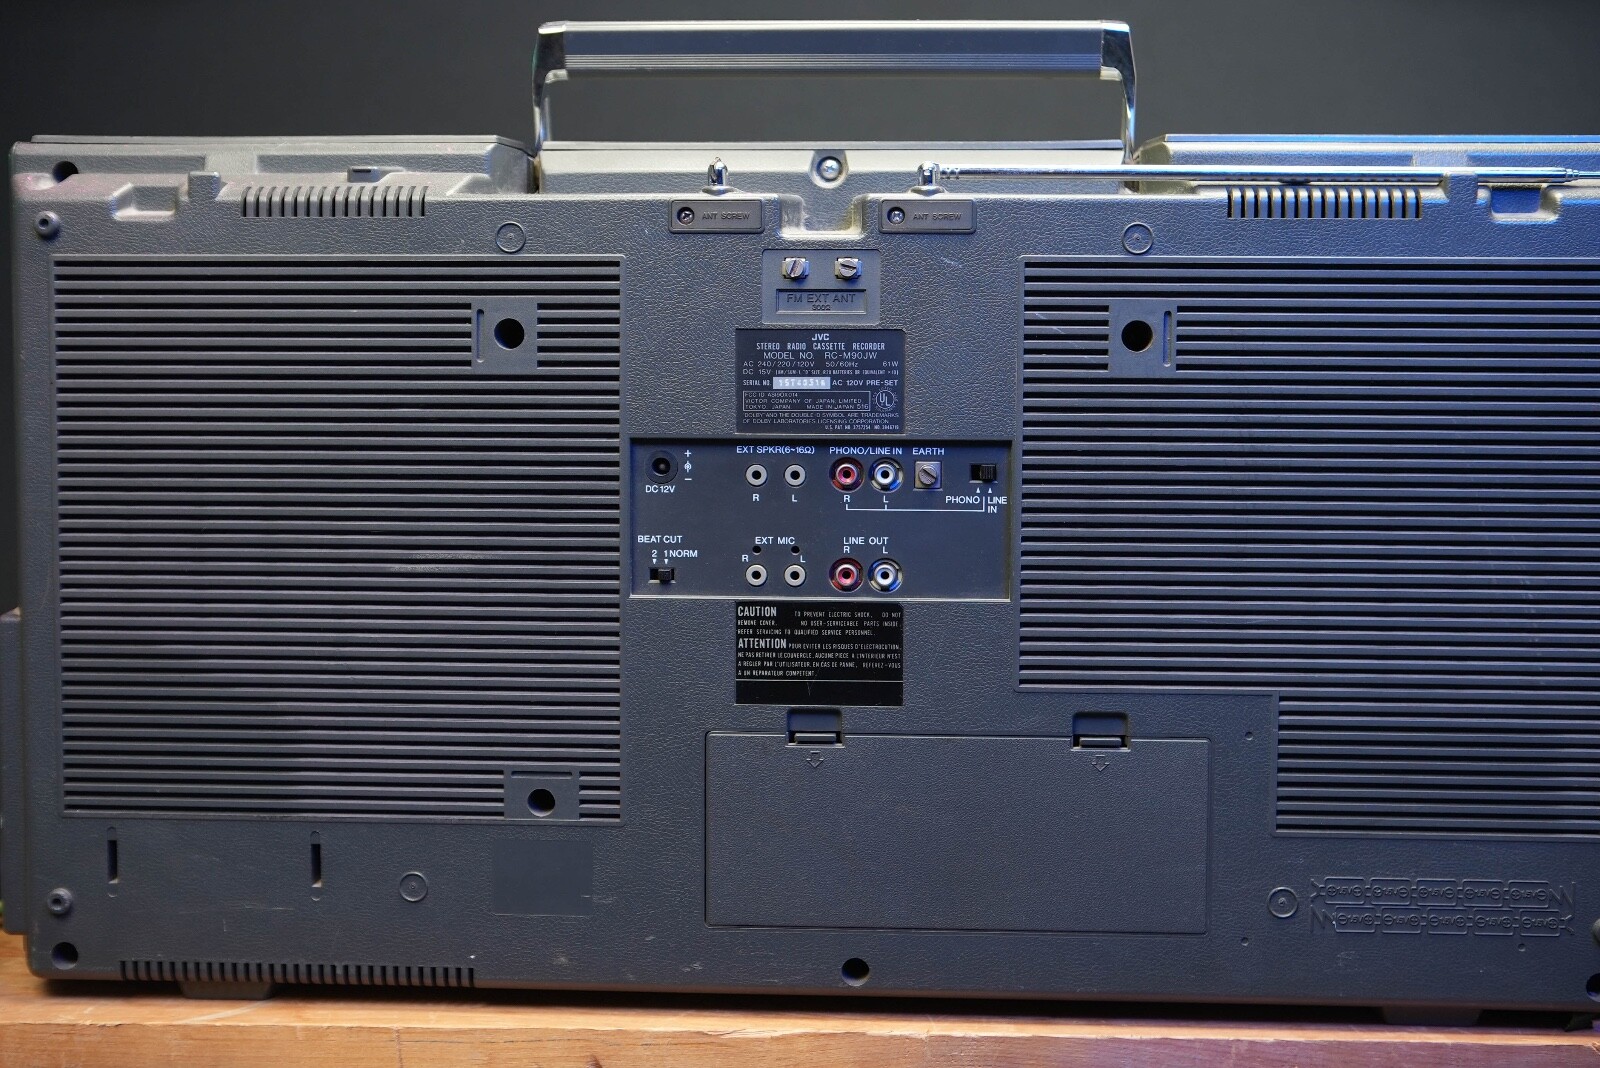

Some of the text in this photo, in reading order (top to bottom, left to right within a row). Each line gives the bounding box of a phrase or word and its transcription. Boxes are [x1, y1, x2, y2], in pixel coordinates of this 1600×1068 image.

[720, 212, 750, 220] SCREW
[787, 294, 856, 302] FM EXT ANT
[880, 393, 890, 406] UL
[736, 446, 754, 454] EXT
[829, 447, 903, 455] PHONO/LINE IN
[645, 485, 675, 493] DC 12V
[752, 494, 760, 502] R
[791, 494, 798, 502] L
[844, 495, 850, 503] R
[883, 495, 889, 503] L
[945, 496, 980, 504] PHONO
[988, 496, 1008, 504] LINE
[988, 506, 997, 514] IN
[638, 535, 682, 543] BEAT CUT
[755, 537, 795, 545] EXT MIC
[843, 537, 889, 545] LINE OUT
[652, 550, 658, 558] 2
[669, 550, 698, 558] NORM
[843, 546, 850, 554] R
[883, 546, 888, 554] L
[800, 555, 806, 563] L
[737, 606, 777, 617] CAUTION
[738, 638, 787, 649] ATTENTION
